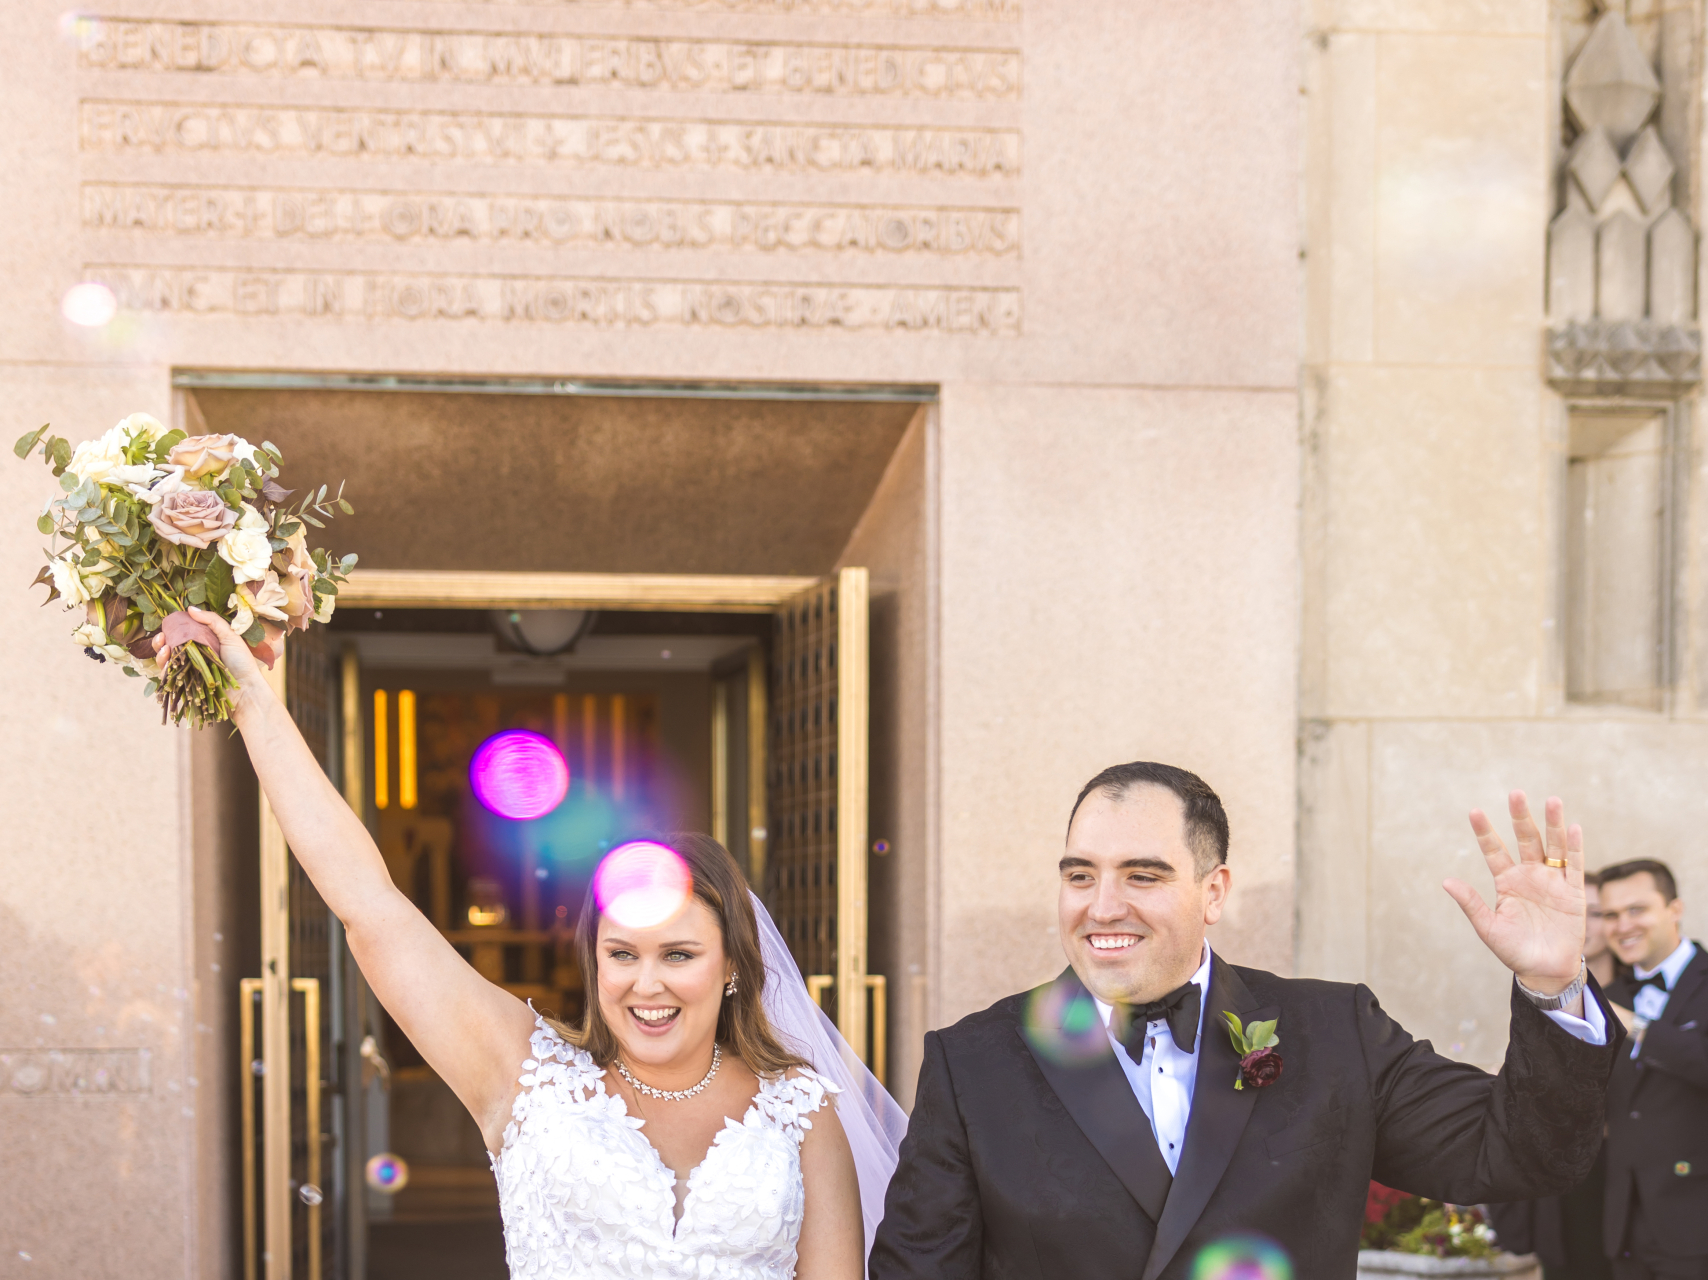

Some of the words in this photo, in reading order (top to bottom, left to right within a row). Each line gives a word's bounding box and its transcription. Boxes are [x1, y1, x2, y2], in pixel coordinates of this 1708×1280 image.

[727, 46, 769, 92] ET
[782, 48, 1014, 98] BENEDICTVS
[890, 130, 1016, 175] MARIA
[380, 195, 480, 241] ORA
[488, 200, 580, 243] PRO
